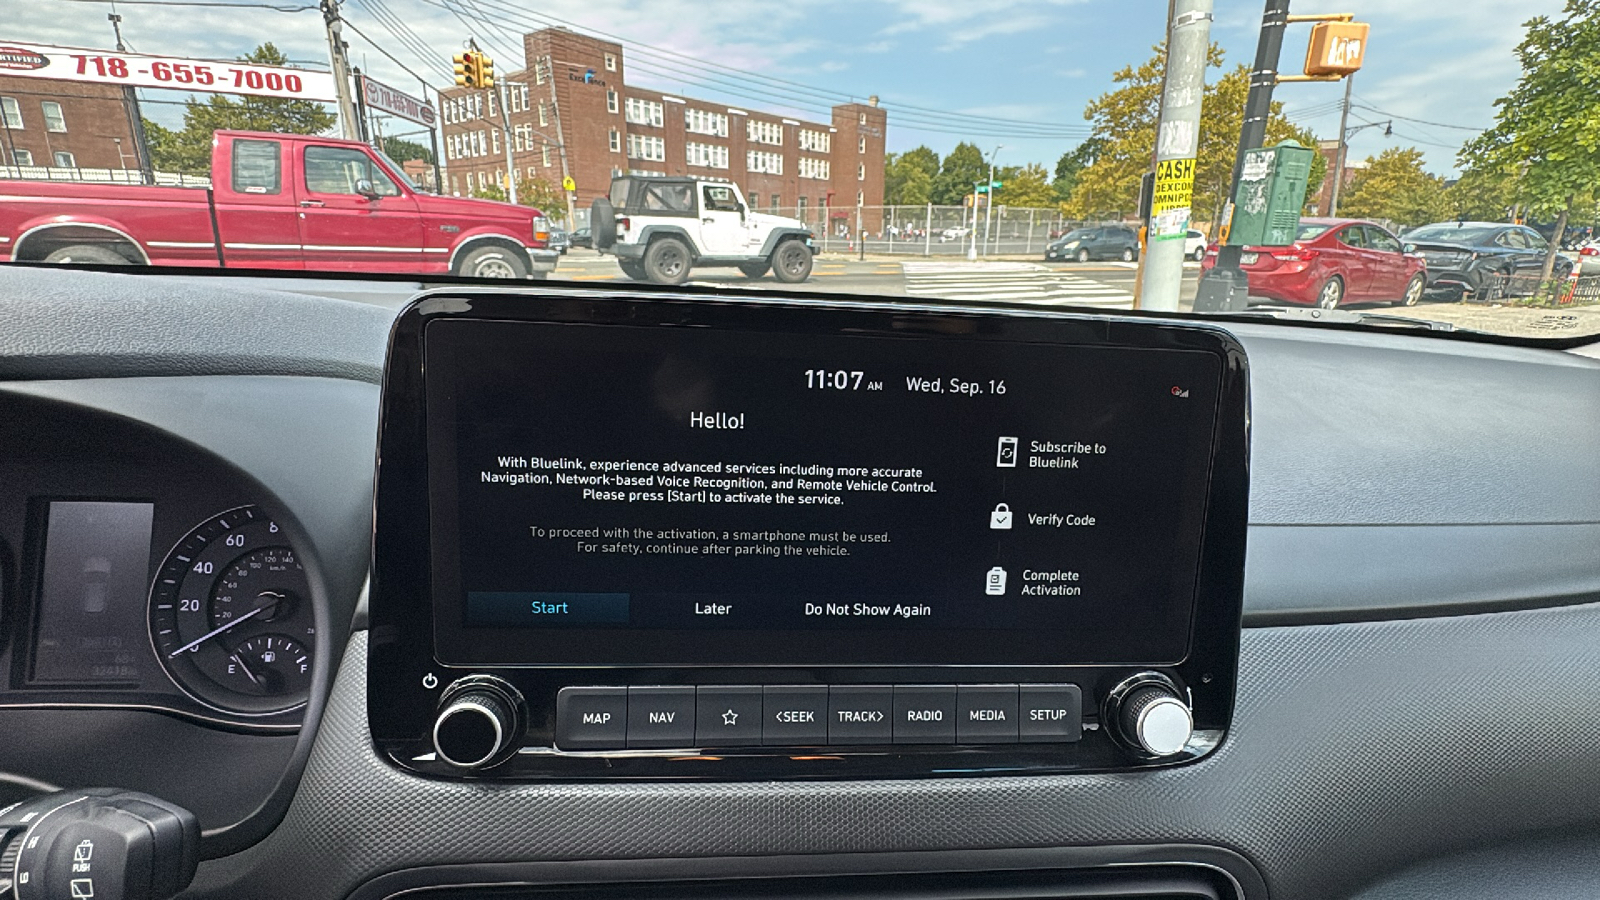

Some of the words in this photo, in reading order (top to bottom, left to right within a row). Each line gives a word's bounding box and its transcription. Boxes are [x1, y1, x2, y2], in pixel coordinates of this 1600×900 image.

[1157, 160, 1192, 181] CASH
[804, 369, 864, 391] 11:07
[867, 381, 883, 391] AM
[906, 377, 945, 395] Wed,
[950, 378, 984, 398] Sep.
[989, 380, 1007, 395] 16
[690, 411, 745, 430] Hello!
[1030, 440, 1092, 455] Subscribe
[1095, 443, 1106, 455] to
[498, 456, 527, 469] With
[531, 456, 586, 472] Bluelink,
[589, 460, 659, 475] experience
[662, 460, 721, 474] advanced
[725, 462, 775, 475] services
[779, 463, 834, 478] including
[837, 467, 869, 477] more
[872, 466, 923, 478] accurate
[1029, 456, 1079, 469] Bluelink
[481, 472, 553, 487] Navigation,
[556, 473, 654, 487] Network-based
[657, 475, 690, 487] Voice
[694, 476, 767, 492] Recognition,
[771, 478, 794, 490] and
[797, 479, 842, 492] Remote
[846, 480, 888, 492] Vehicle
[891, 481, 937, 493] Control.
[583, 489, 625, 501] Please
[629, 492, 664, 504] press
[667, 490, 706, 504] [Start]
[709, 492, 722, 503] to
[725, 492, 773, 505] activate
[775, 493, 795, 505] the
[798, 493, 844, 506] service.
[1028, 513, 1064, 528] Verify
[1067, 514, 1096, 526] Code
[226, 534, 245, 547] 60
[530, 527, 545, 538] To
[549, 527, 600, 541] proceed
[603, 528, 630, 539] with
[633, 528, 653, 540] the
[656, 528, 718, 542] activation,
[721, 531, 729, 541] a
[732, 529, 806, 545] smartphone
[809, 531, 839, 542] must
[842, 531, 857, 543] be
[861, 531, 891, 543] used.
[577, 542, 598, 554] For
[601, 542, 643, 556] safety,
[646, 543, 699, 555] continue
[702, 543, 732, 555] after
[735, 544, 781, 559] parking
[784, 544, 803, 556] the
[806, 544, 851, 557] vehicle.
[193, 562, 214, 575] 40
[1022, 569, 1080, 584] Complete
[1021, 583, 1081, 596] Activation
[180, 599, 200, 612] 20
[531, 600, 568, 615] Start
[695, 601, 732, 616] Later
[805, 603, 824, 616] Do
[826, 603, 850, 616] Not
[852, 602, 891, 617] Show
[893, 602, 932, 620] Again
[228, 664, 236, 674] E
[301, 664, 308, 674] F
[583, 712, 611, 725] MAP
[649, 711, 676, 724] NAV
[907, 710, 943, 722] RADIO
[969, 709, 1006, 722] MEDIA
[1029, 708, 1067, 722] SETUP
[72, 863, 91, 873] PUSH
